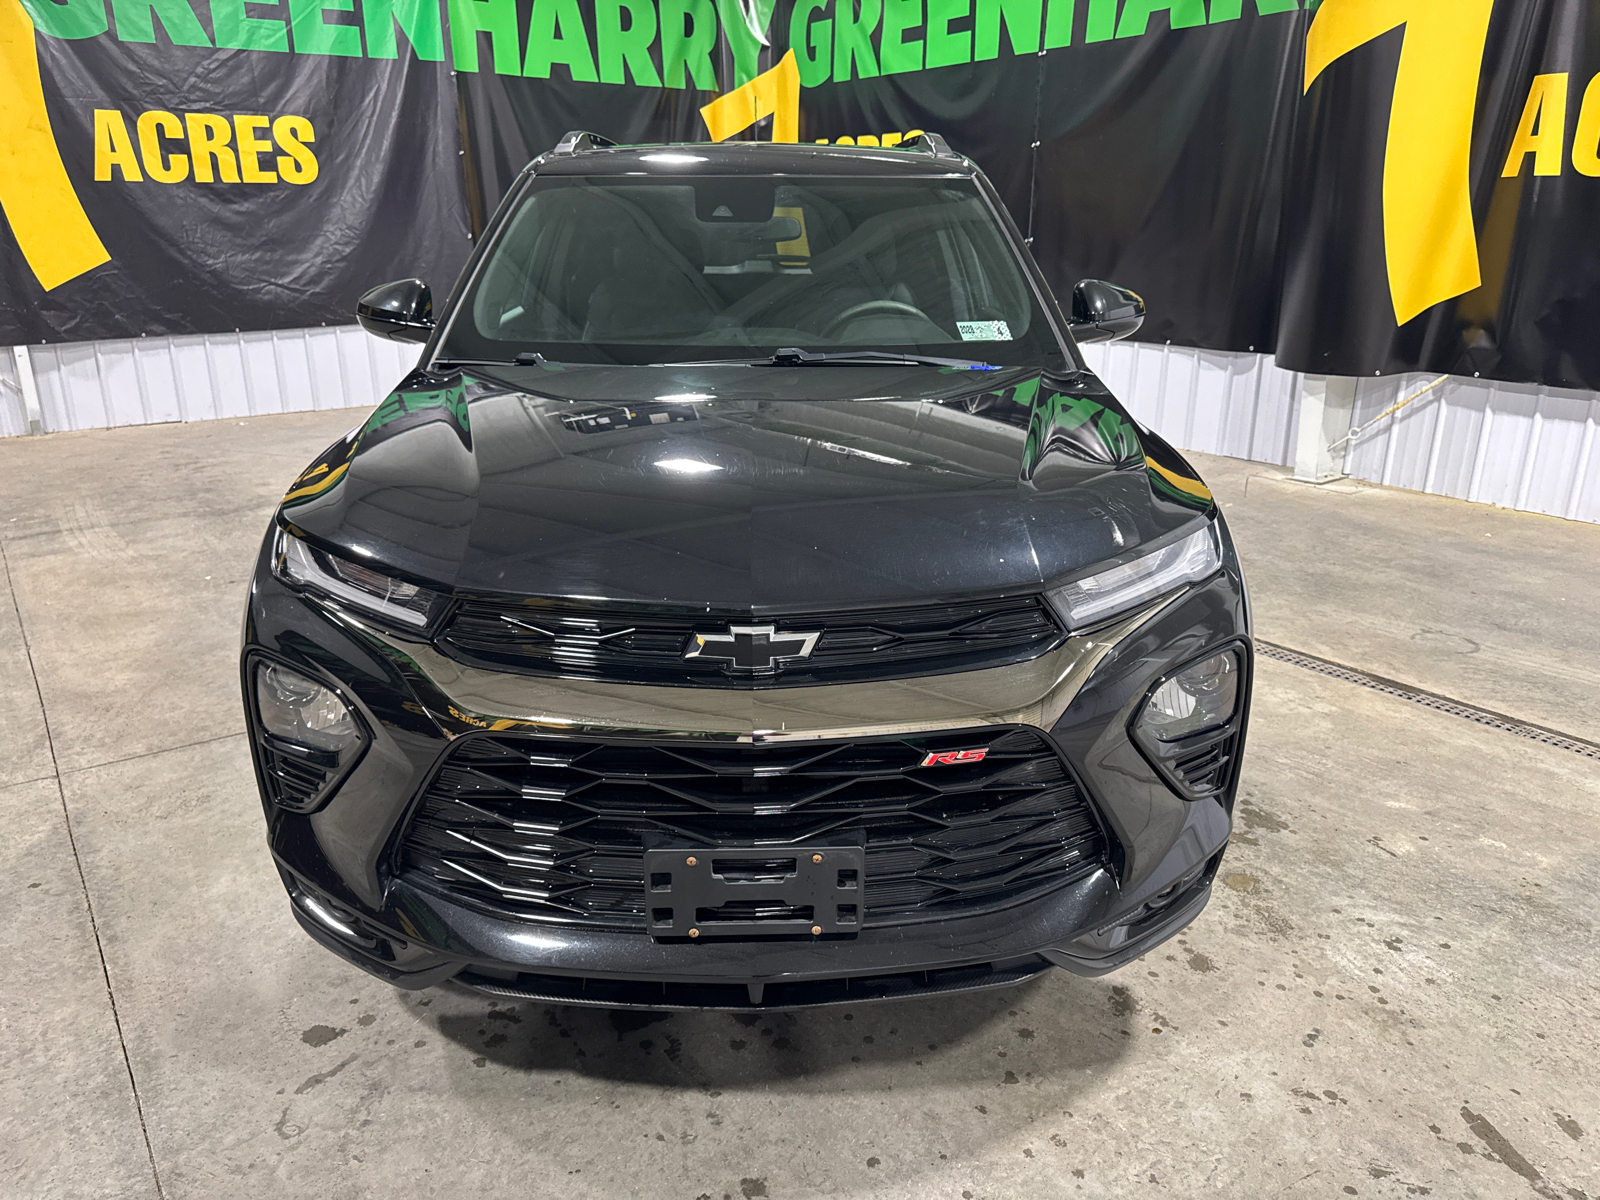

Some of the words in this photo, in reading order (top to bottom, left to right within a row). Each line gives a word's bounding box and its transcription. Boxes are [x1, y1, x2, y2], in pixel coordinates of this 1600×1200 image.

[448, 0, 777, 92] HARRY
[789, 0, 1041, 88] GREEN
[94, 108, 319, 185] ACRES
[921, 748, 989, 767] RS
